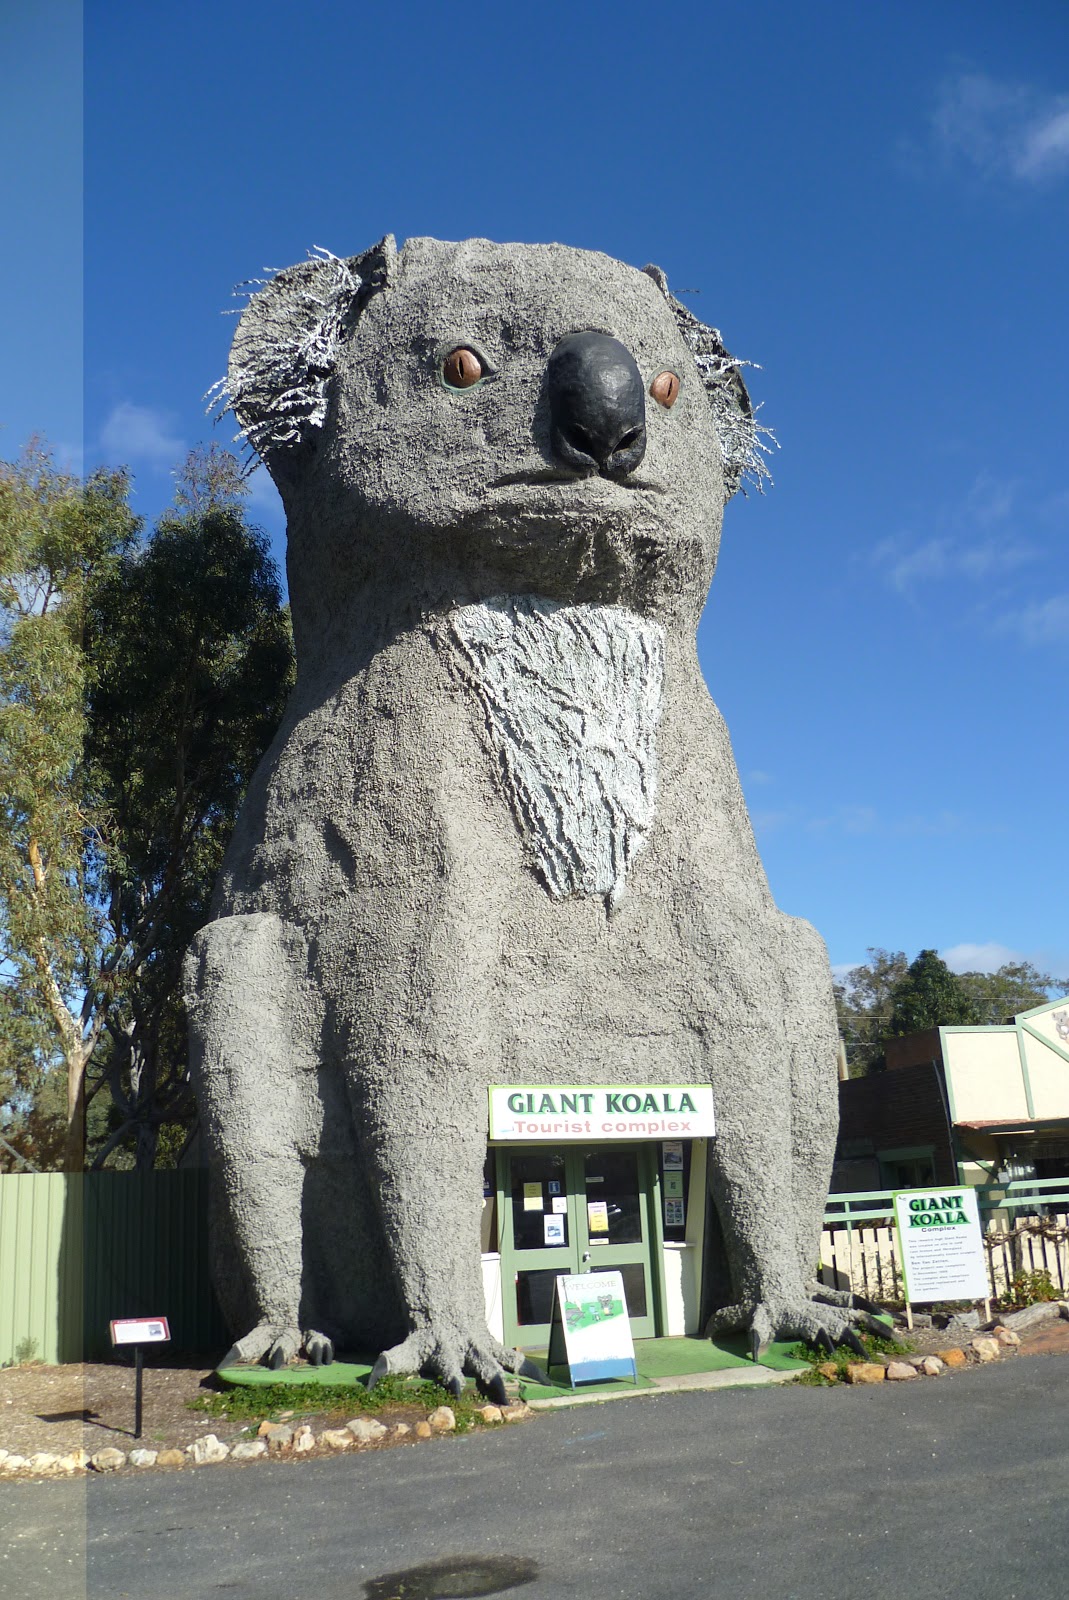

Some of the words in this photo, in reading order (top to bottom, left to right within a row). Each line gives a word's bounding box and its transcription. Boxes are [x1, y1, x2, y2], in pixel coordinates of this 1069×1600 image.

[507, 1093, 595, 1114] GIANT
[605, 1093, 697, 1114] KOALA
[514, 1120, 591, 1133] Tourist
[601, 1119, 691, 1134] complex
[908, 1195, 963, 1212] GIANT
[908, 1211, 970, 1228] KOALA
[565, 1280, 617, 1291] WELCOME
